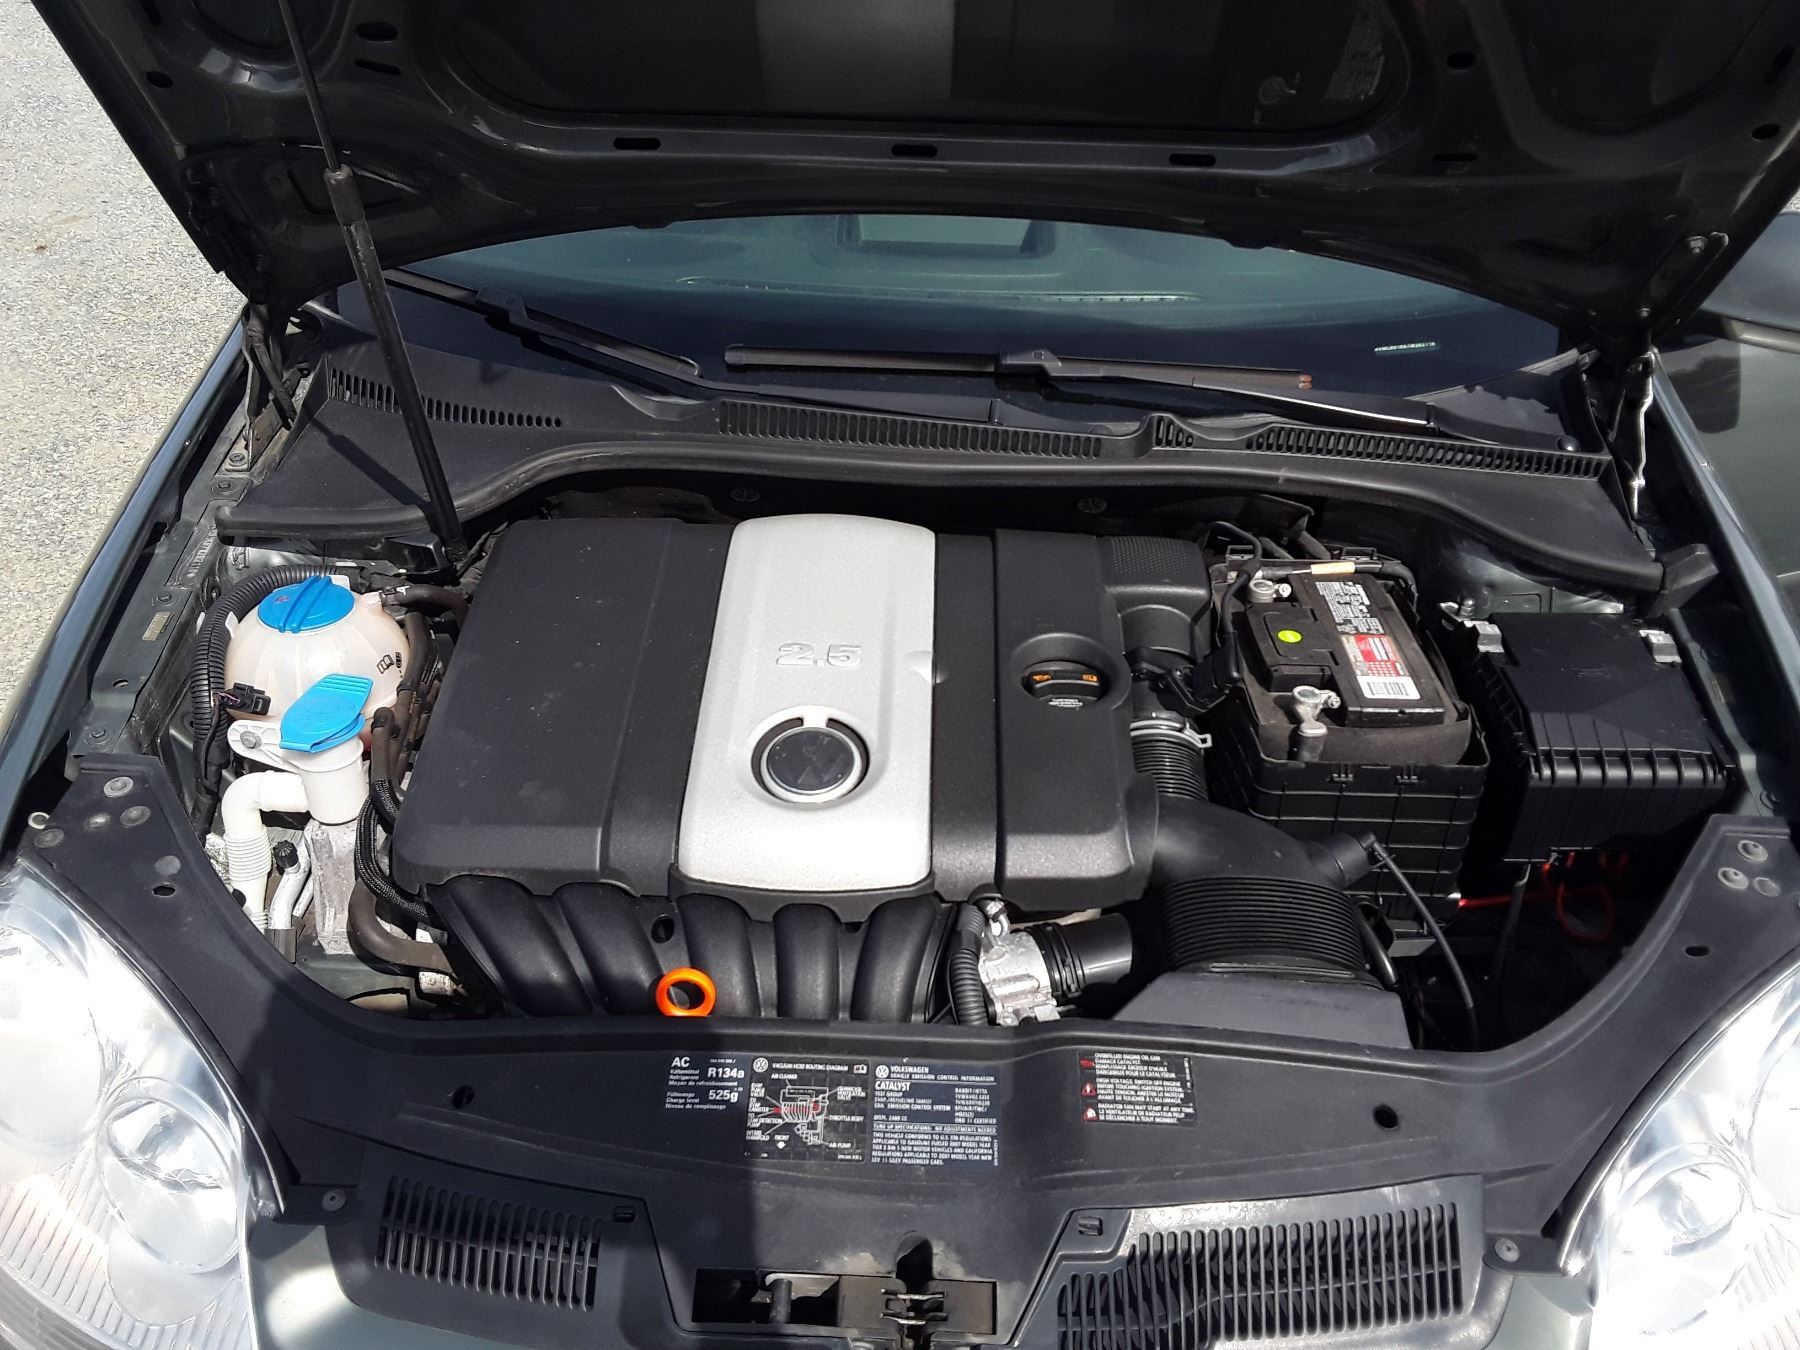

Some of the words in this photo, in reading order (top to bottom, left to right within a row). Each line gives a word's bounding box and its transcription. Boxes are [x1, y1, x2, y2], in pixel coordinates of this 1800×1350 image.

[776, 642, 862, 666] 2.5
[672, 1056, 690, 1067] AC
[708, 1067, 744, 1078] R134a
[875, 1081, 911, 1091] CATALYST
[708, 1090, 738, 1102] 525g
